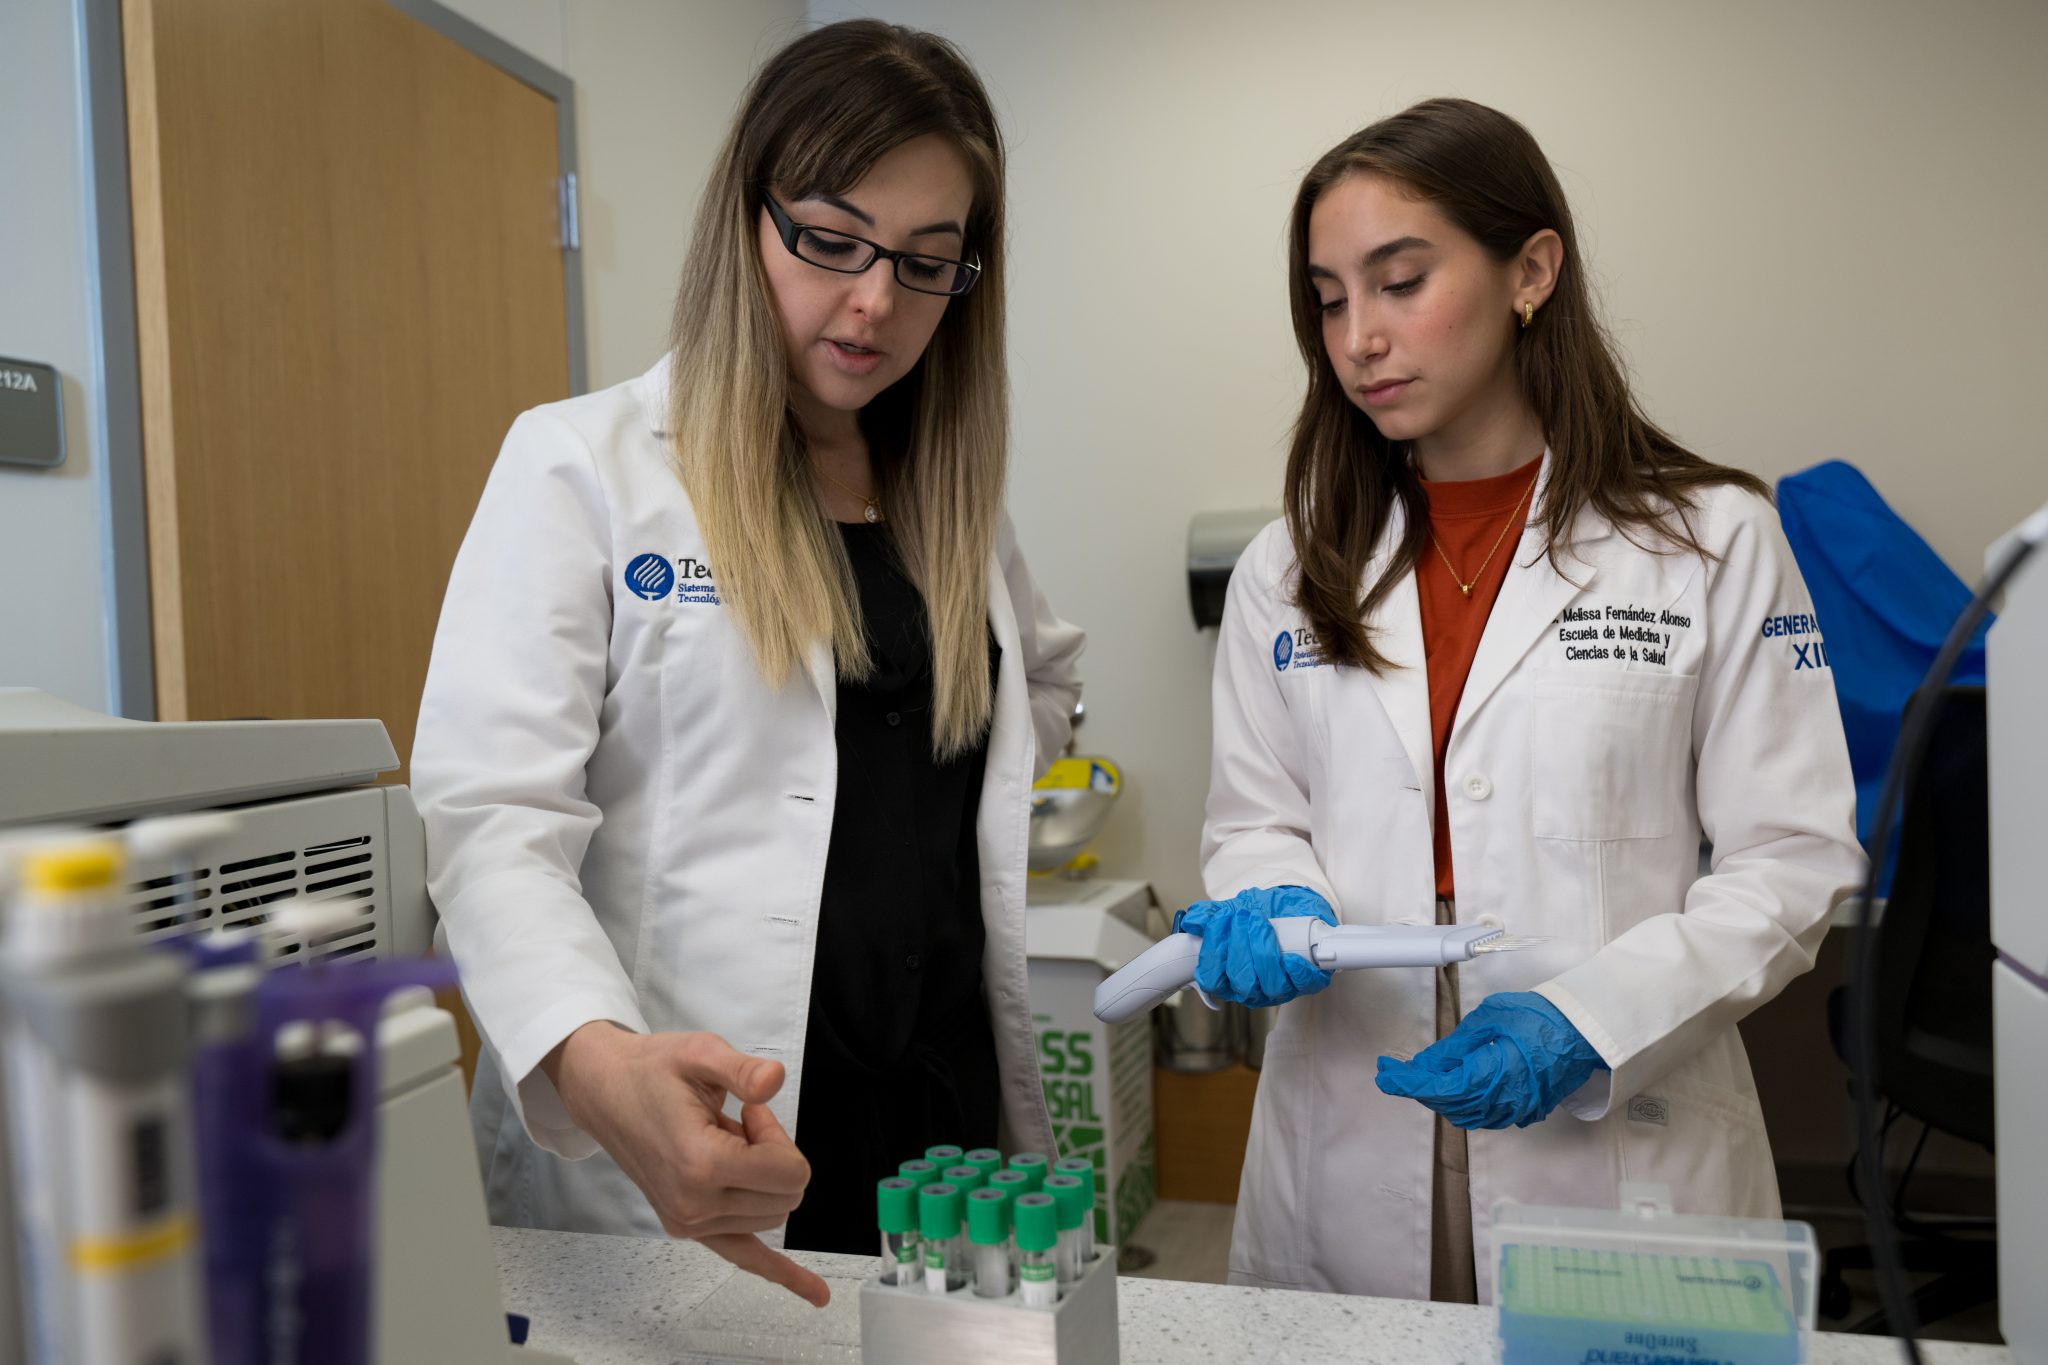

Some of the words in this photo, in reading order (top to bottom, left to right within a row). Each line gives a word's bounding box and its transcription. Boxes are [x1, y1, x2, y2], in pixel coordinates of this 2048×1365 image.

[678, 584, 715, 593] Sistema
[1563, 608, 1601, 623] Melissa
[1606, 604, 1656, 624] Fernández
[1660, 610, 1691, 628] Alonso
[1762, 613, 1820, 638] GENERA
[1559, 626, 1598, 641] Escuela
[1603, 625, 1615, 639] de
[1620, 626, 1660, 644] Medicina
[1665, 633, 1671, 649] y
[1566, 645, 1609, 661] Ciencias
[1614, 645, 1626, 660] de
[1630, 646, 1638, 661] la
[1643, 648, 1666, 666] Salud
[1036, 1030, 1093, 1076] SS
[1624, 1331, 1697, 1353] SureOne
